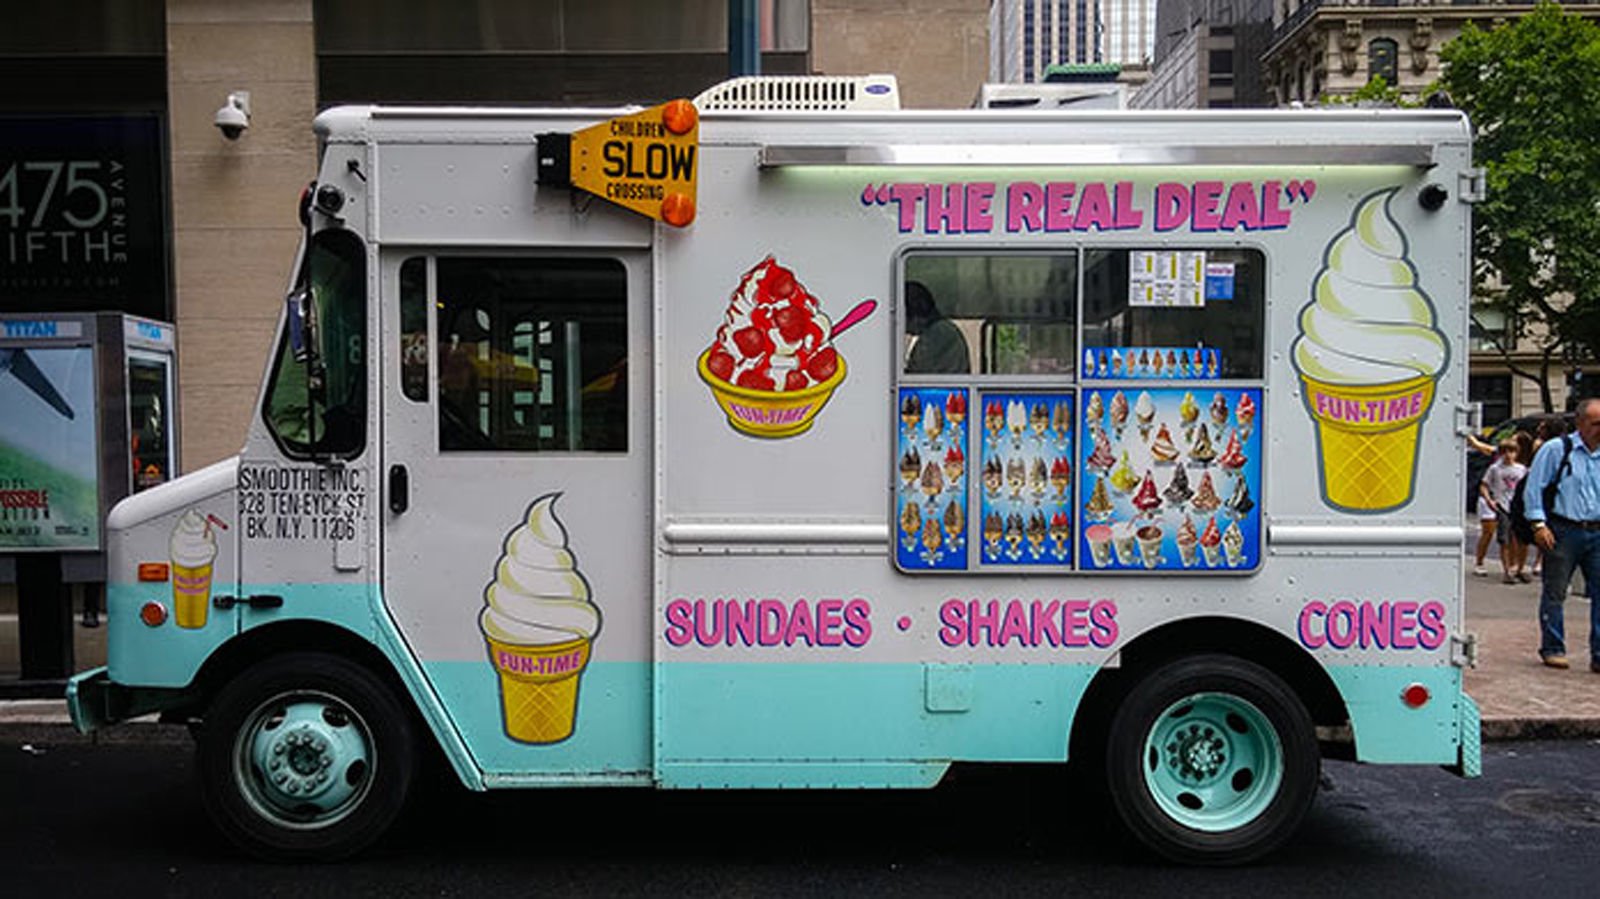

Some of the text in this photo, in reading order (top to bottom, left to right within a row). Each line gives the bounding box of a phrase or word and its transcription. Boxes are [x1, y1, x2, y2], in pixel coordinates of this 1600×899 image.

[602, 140, 696, 182] SLOW
[606, 182, 665, 201] CROSSING
[110, 160, 127, 263] AVENUE
[1005, 181, 1143, 233] REAL
[3, 321, 57, 336] TITAN
[729, 402, 814, 425] FUN-TIME
[1315, 391, 1424, 423] FUN-TIME
[240, 467, 365, 492] SMOOTHIE INC.
[247, 516, 272, 539] BK.
[312, 516, 356, 541] 11206
[664, 598, 1447, 650] SUNDAES SHAKES CONES
[497, 650, 582, 675] FUN-TIME
